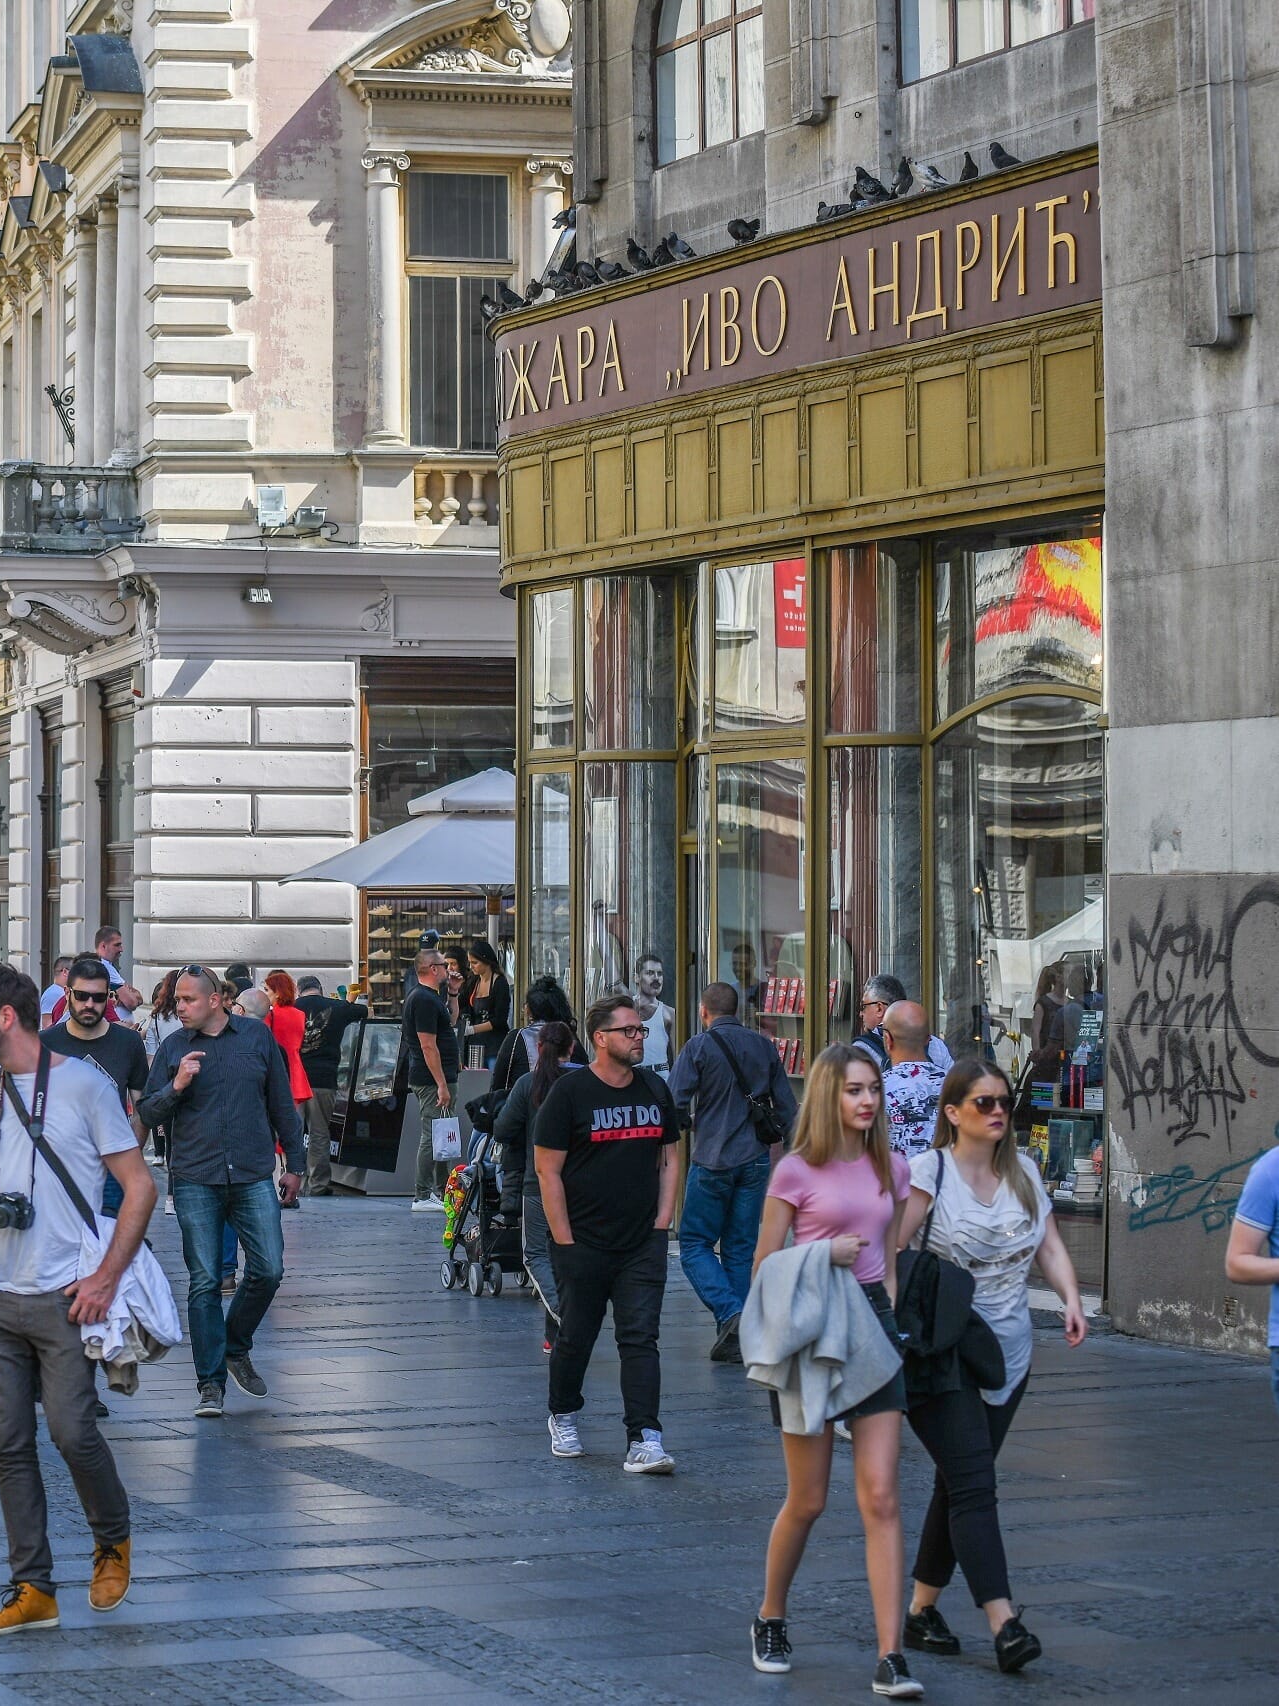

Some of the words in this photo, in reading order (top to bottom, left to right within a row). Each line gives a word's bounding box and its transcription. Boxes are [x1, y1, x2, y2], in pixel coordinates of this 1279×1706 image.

[35, 1091, 44, 1117] Canon
[591, 1106, 632, 1131] JUST
[635, 1104, 661, 1126] DO
